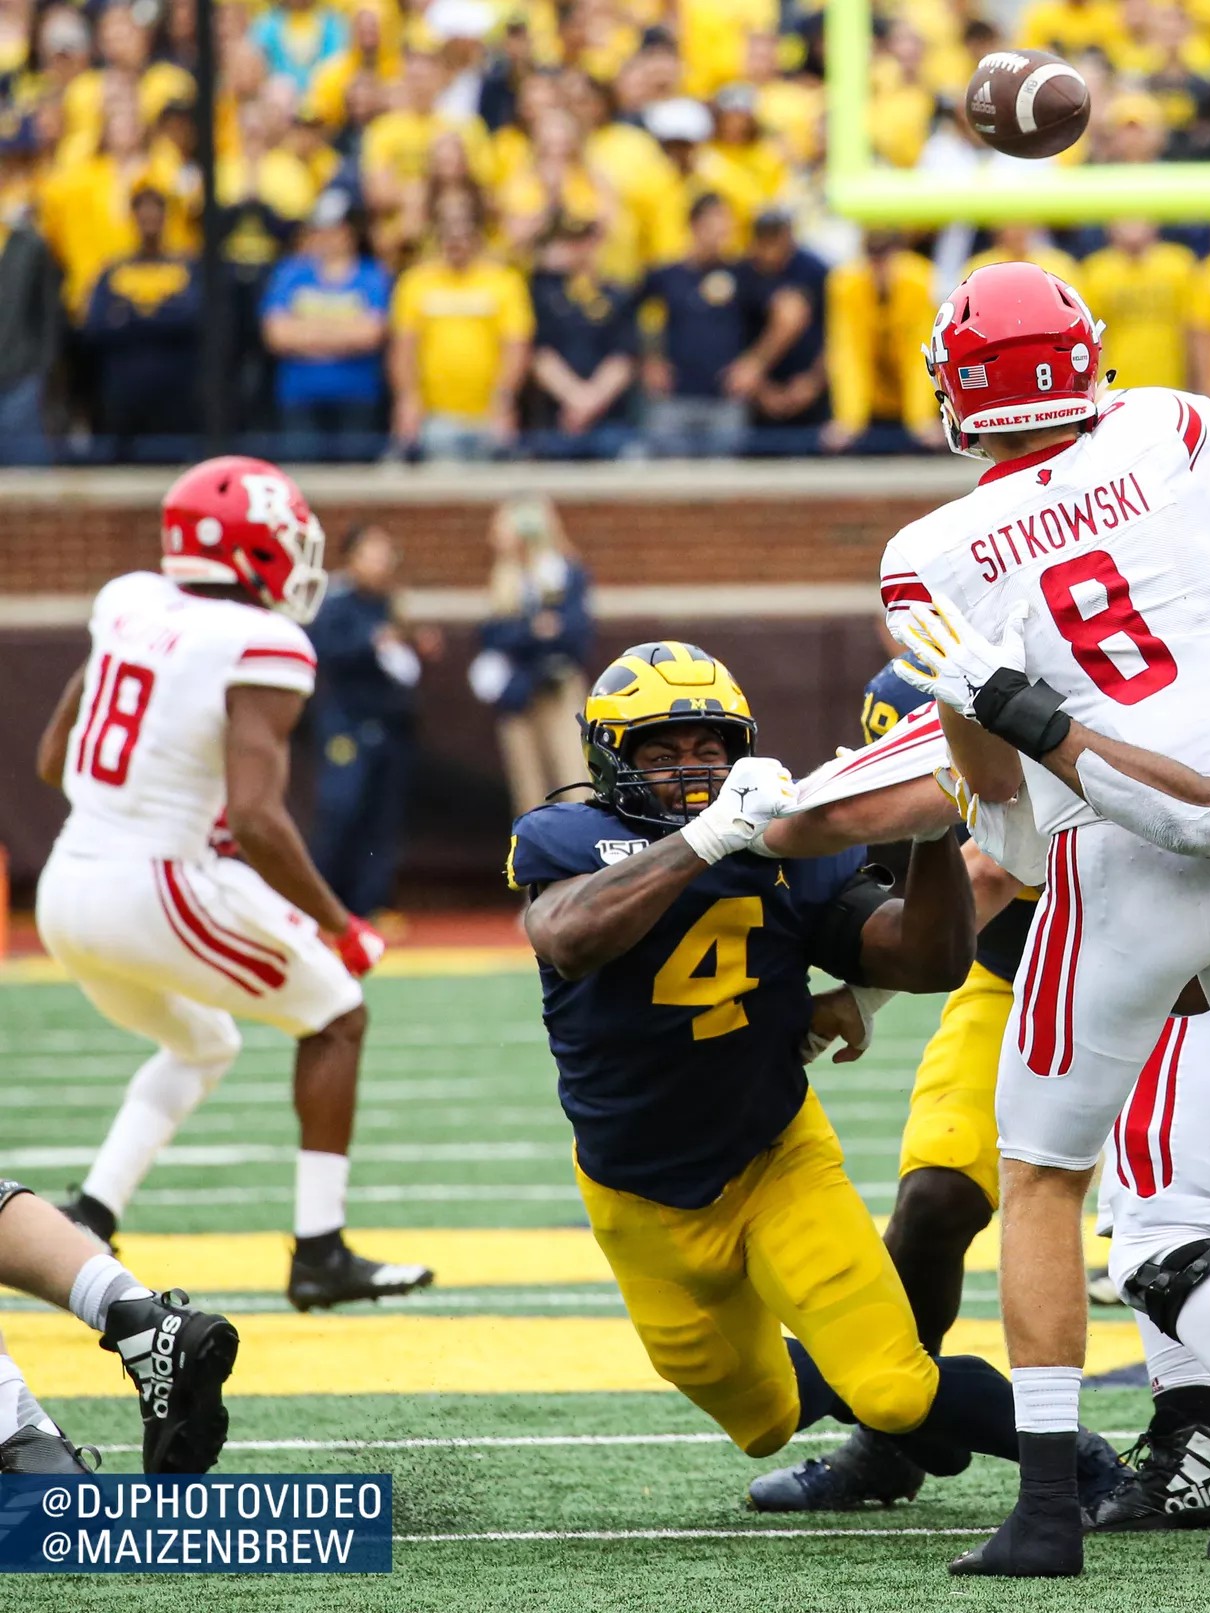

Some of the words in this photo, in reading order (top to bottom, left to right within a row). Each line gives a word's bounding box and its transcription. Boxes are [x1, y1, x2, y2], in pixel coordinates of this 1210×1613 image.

[973, 414, 1031, 429] SCARLET
[1035, 406, 1088, 422] KNIGHTS
[1035, 363, 1053, 391] 8
[970, 472, 1151, 584] SITKOWSKI
[1039, 549, 1178, 706] 8
[77, 653, 156, 788] 18
[652, 896, 764, 1041] 4
[152, 1313, 182, 1419] adidas
